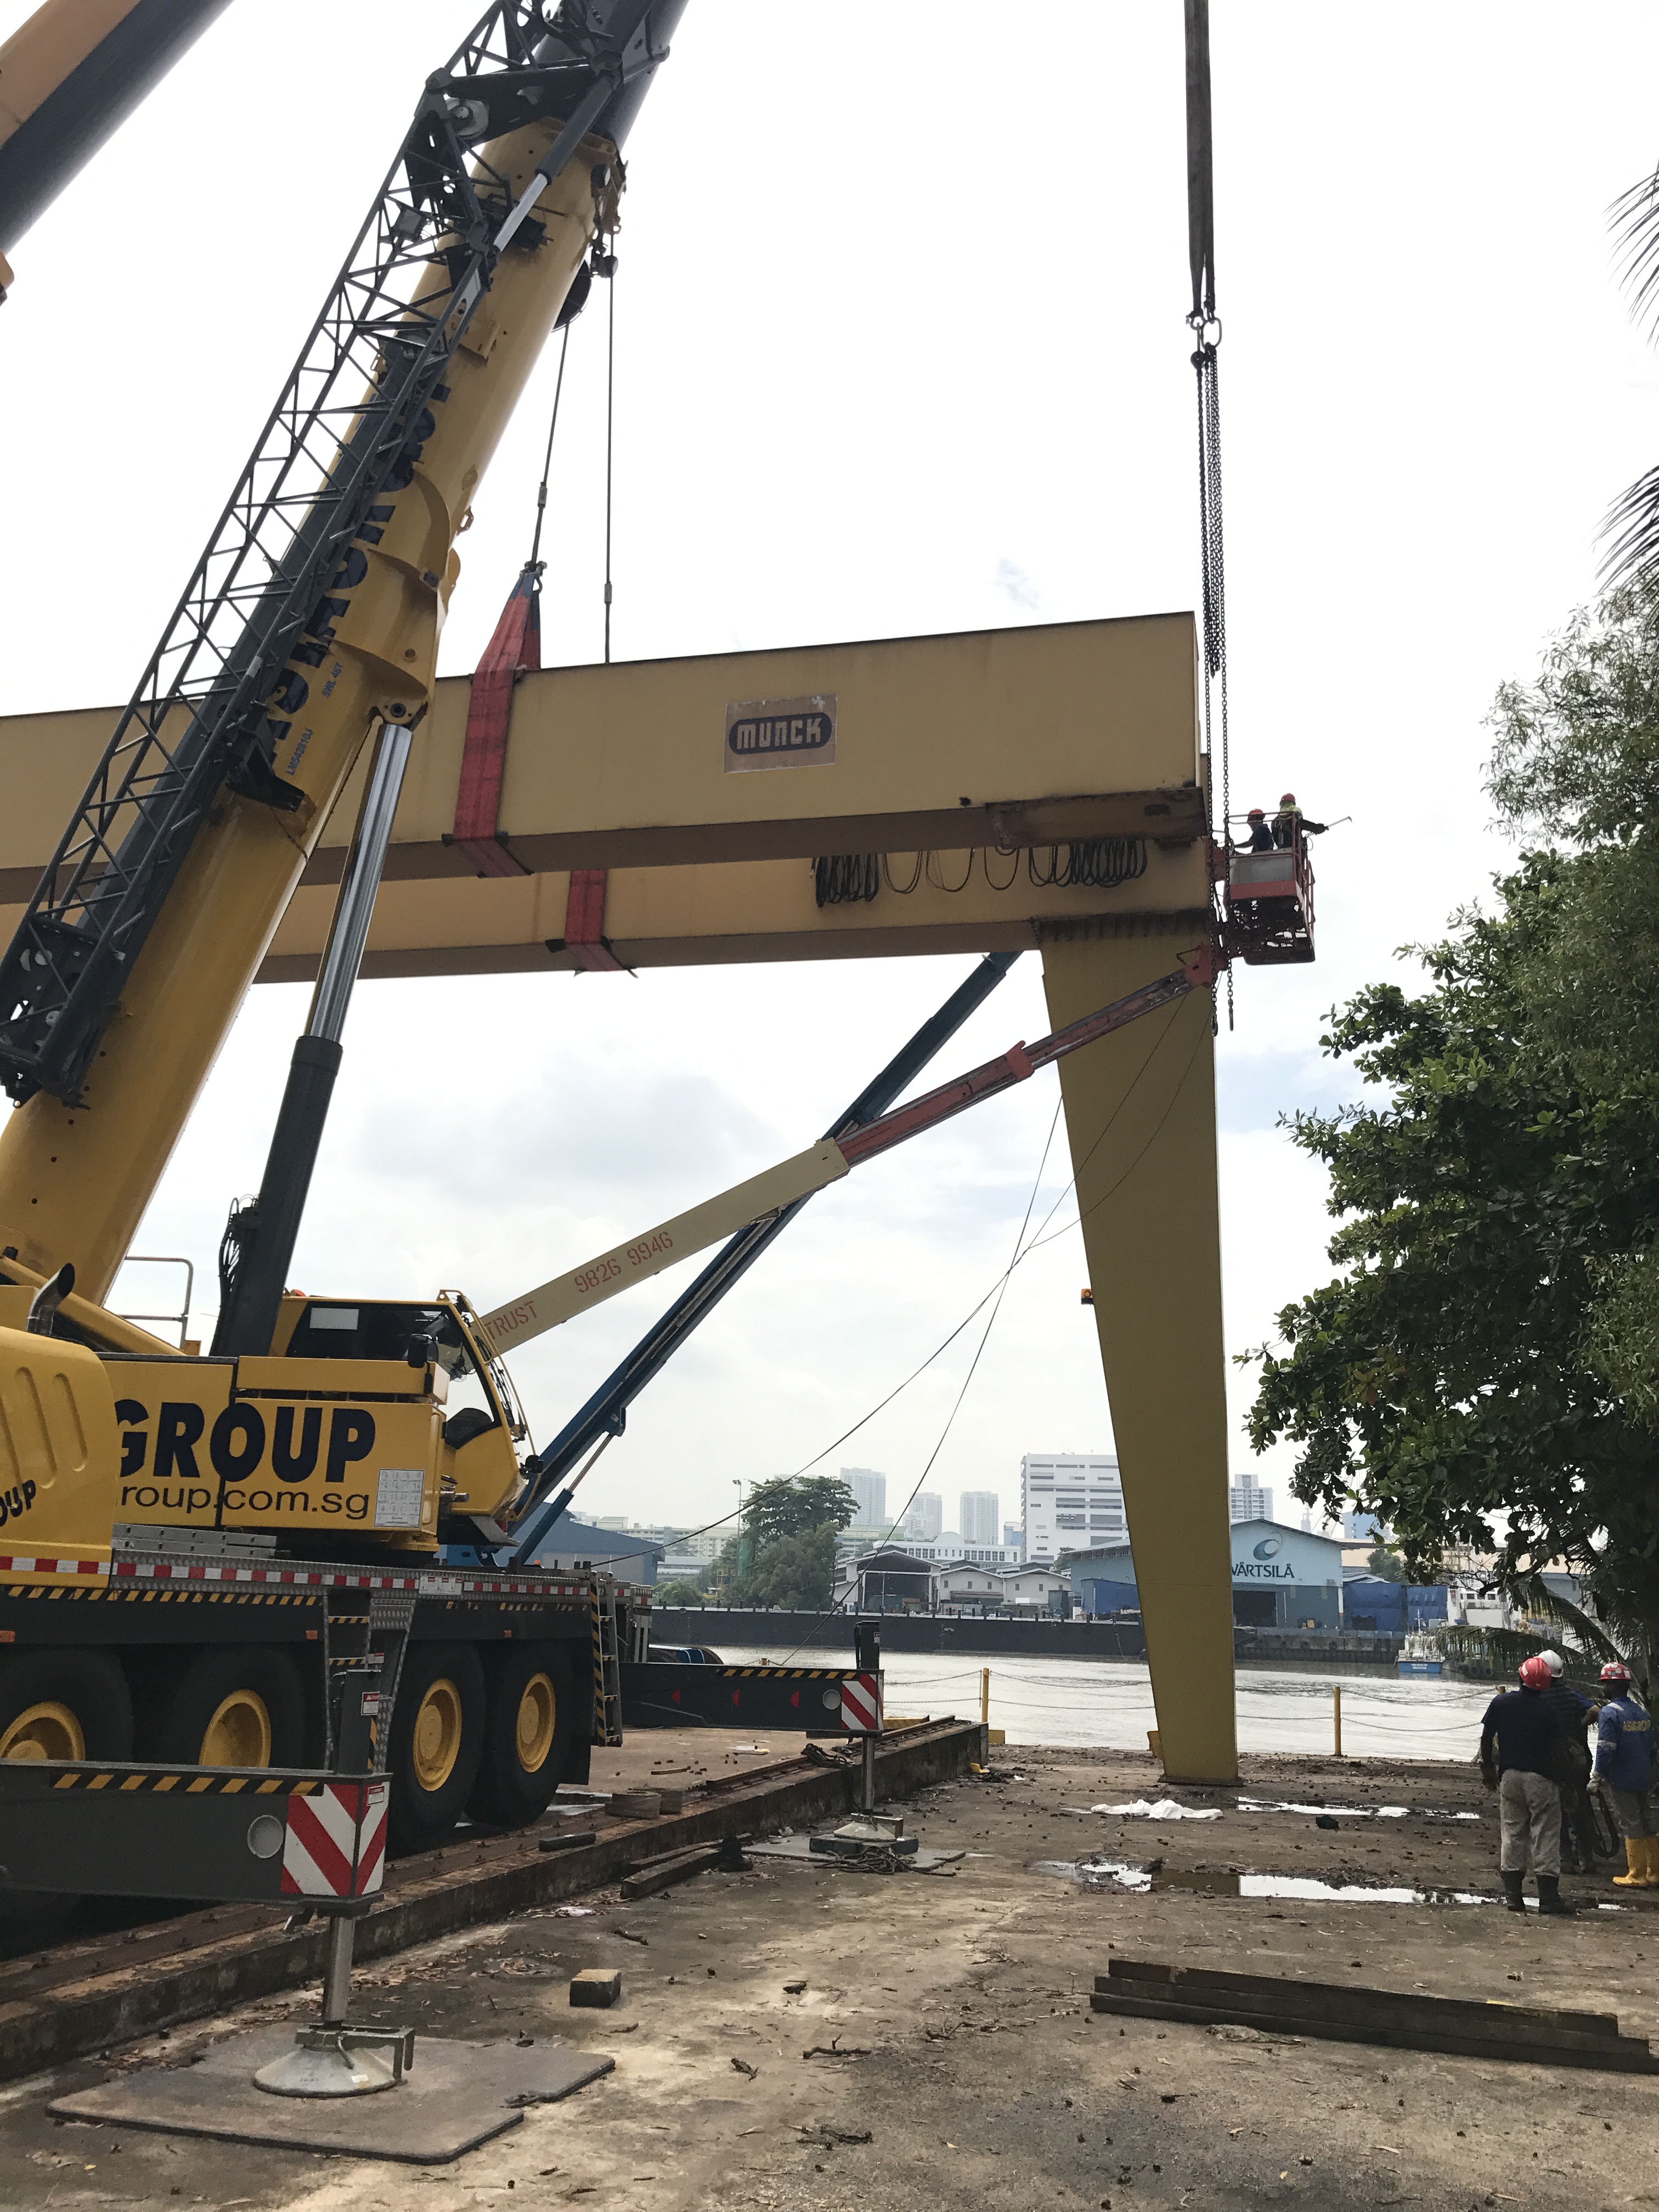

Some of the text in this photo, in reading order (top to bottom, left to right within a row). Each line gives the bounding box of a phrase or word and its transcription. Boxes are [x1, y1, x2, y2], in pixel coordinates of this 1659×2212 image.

[736, 718, 822, 750] MUNCK
[574, 1231, 673, 1293] 9826 9946
[483, 1300, 537, 1340] TRUST
[114, 1398, 376, 1483] GROUP
